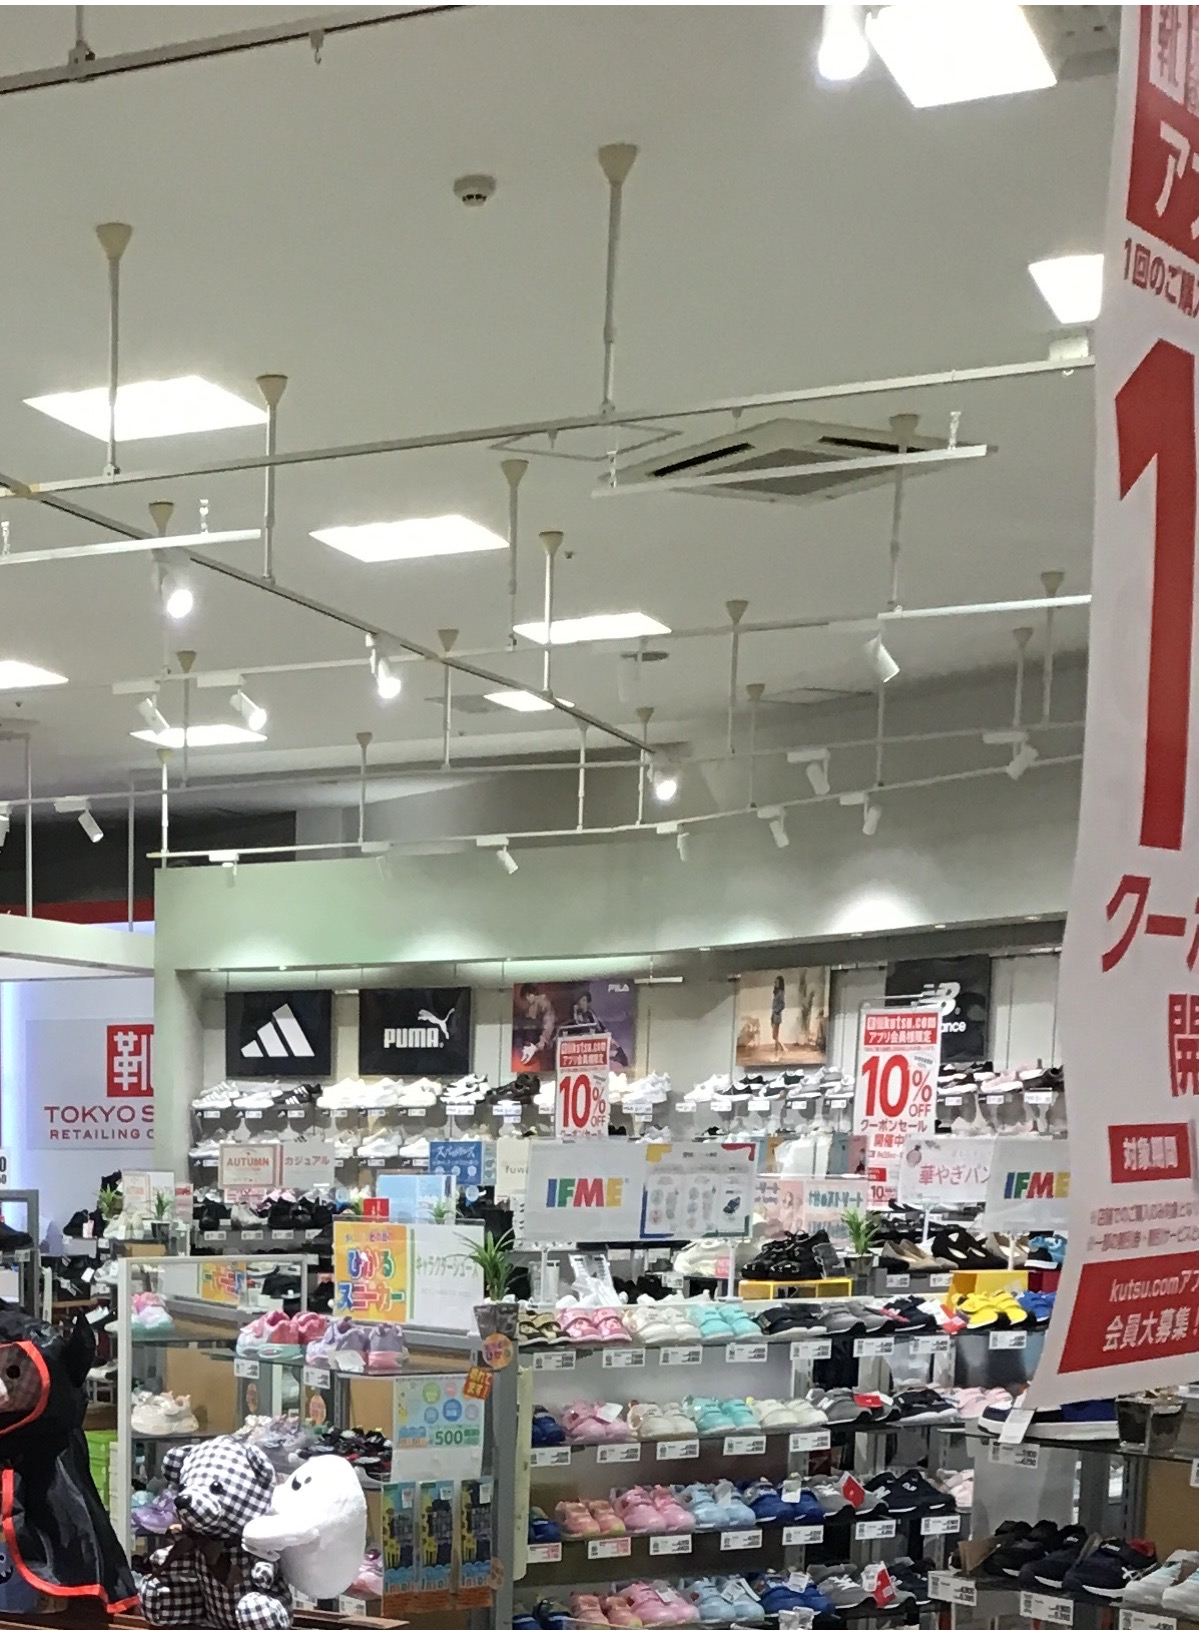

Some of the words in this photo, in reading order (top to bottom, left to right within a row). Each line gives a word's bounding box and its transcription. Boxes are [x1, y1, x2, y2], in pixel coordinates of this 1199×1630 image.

[1102, 873, 1199, 973] クー
[607, 983, 630, 993] FILA
[383, 1027, 440, 1049] PUMA
[44, 1105, 136, 1124] TOKYO
[141, 1104, 155, 1123] S
[908, 1104, 931, 1118] OFF
[590, 1115, 606, 1127] OFF
[861, 1119, 928, 1133] クーポンセール
[49, 1128, 141, 1140] RETAILING
[146, 1128, 155, 1139] C
[227, 1157, 270, 1168] AUTUMN
[284, 1155, 330, 1167] カジュアル
[546, 1178, 624, 1207] IFME
[1004, 1171, 1071, 1199] IFME
[337, 1281, 406, 1312] スニーカー
[434, 1429, 464, 1446] 500
